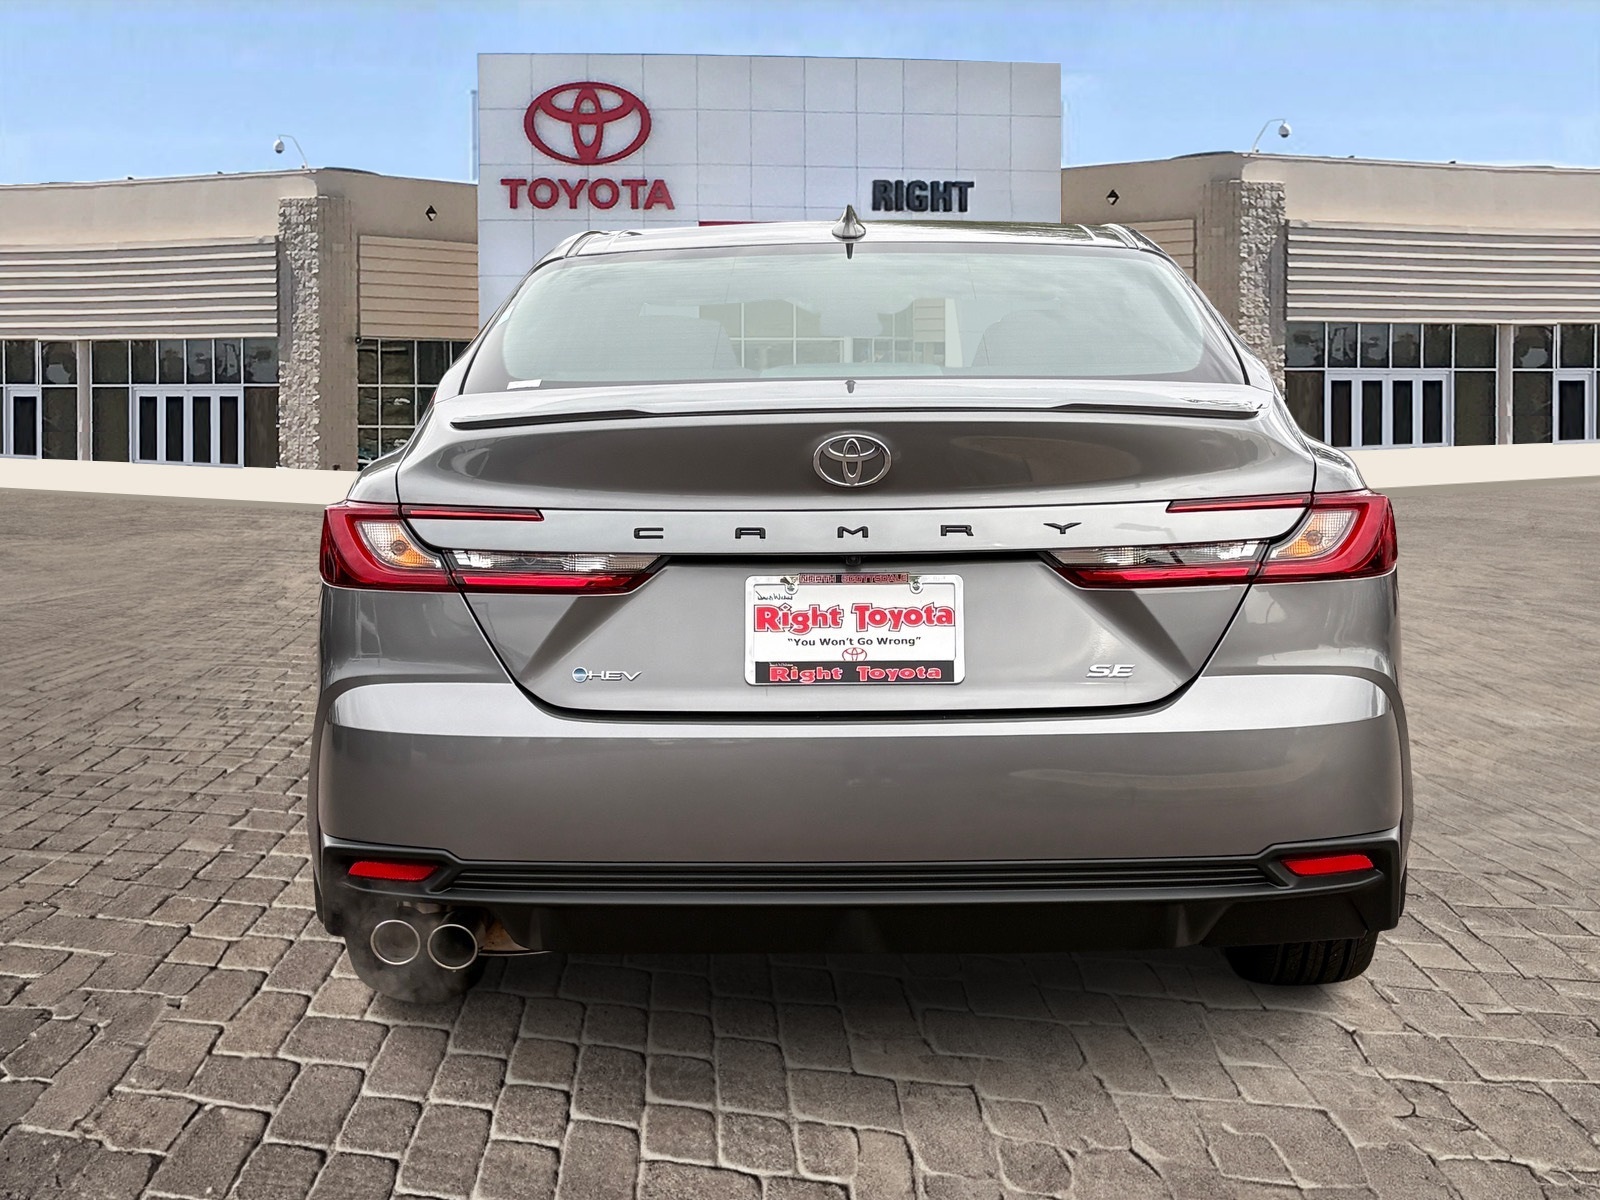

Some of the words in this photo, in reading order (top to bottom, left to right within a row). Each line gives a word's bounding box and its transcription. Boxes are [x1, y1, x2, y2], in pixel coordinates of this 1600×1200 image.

[500, 178, 675, 210] TOYOTA
[872, 179, 975, 213] RIGHT
[633, 521, 1082, 540] CAMRY
[754, 603, 844, 634] Right
[851, 602, 956, 632] Toyota
[857, 637, 873, 645] Go
[588, 670, 642, 681] HEV
[769, 667, 843, 683] Right
[857, 666, 942, 681] Toyota
[1086, 664, 1136, 678] SE
